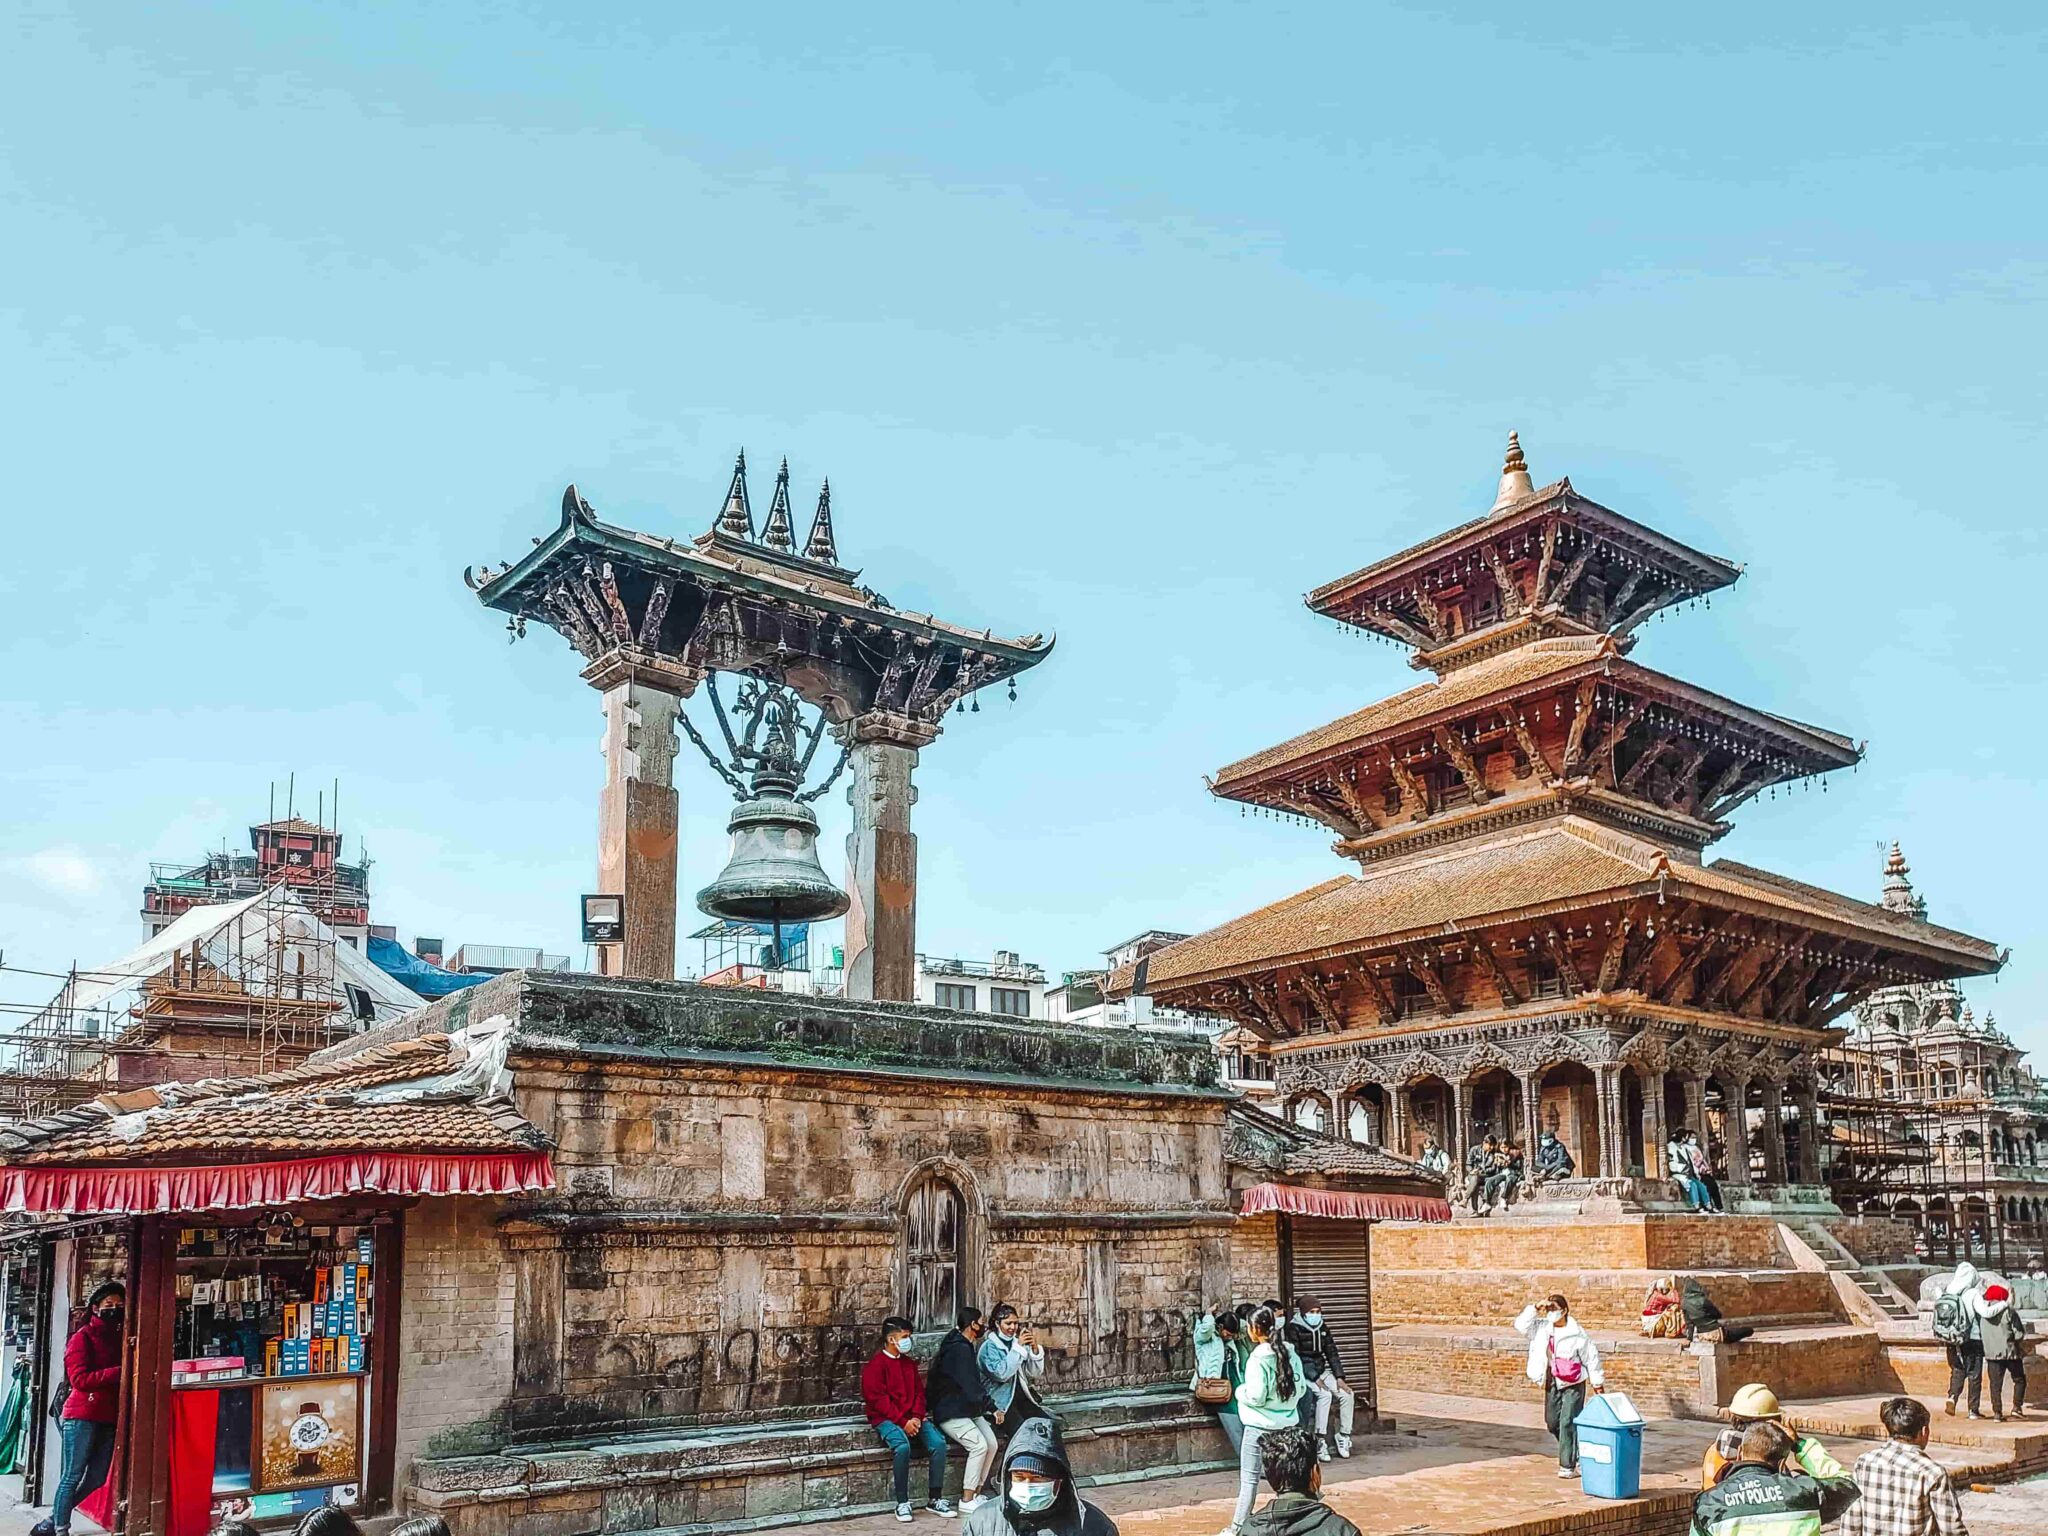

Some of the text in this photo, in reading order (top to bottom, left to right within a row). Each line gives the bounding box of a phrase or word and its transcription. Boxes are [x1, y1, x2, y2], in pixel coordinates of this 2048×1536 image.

[267, 1385, 292, 1393] TIMEX
[1738, 1479, 1761, 1491] LMC
[1724, 1485, 1784, 1507] CITY POLICE
